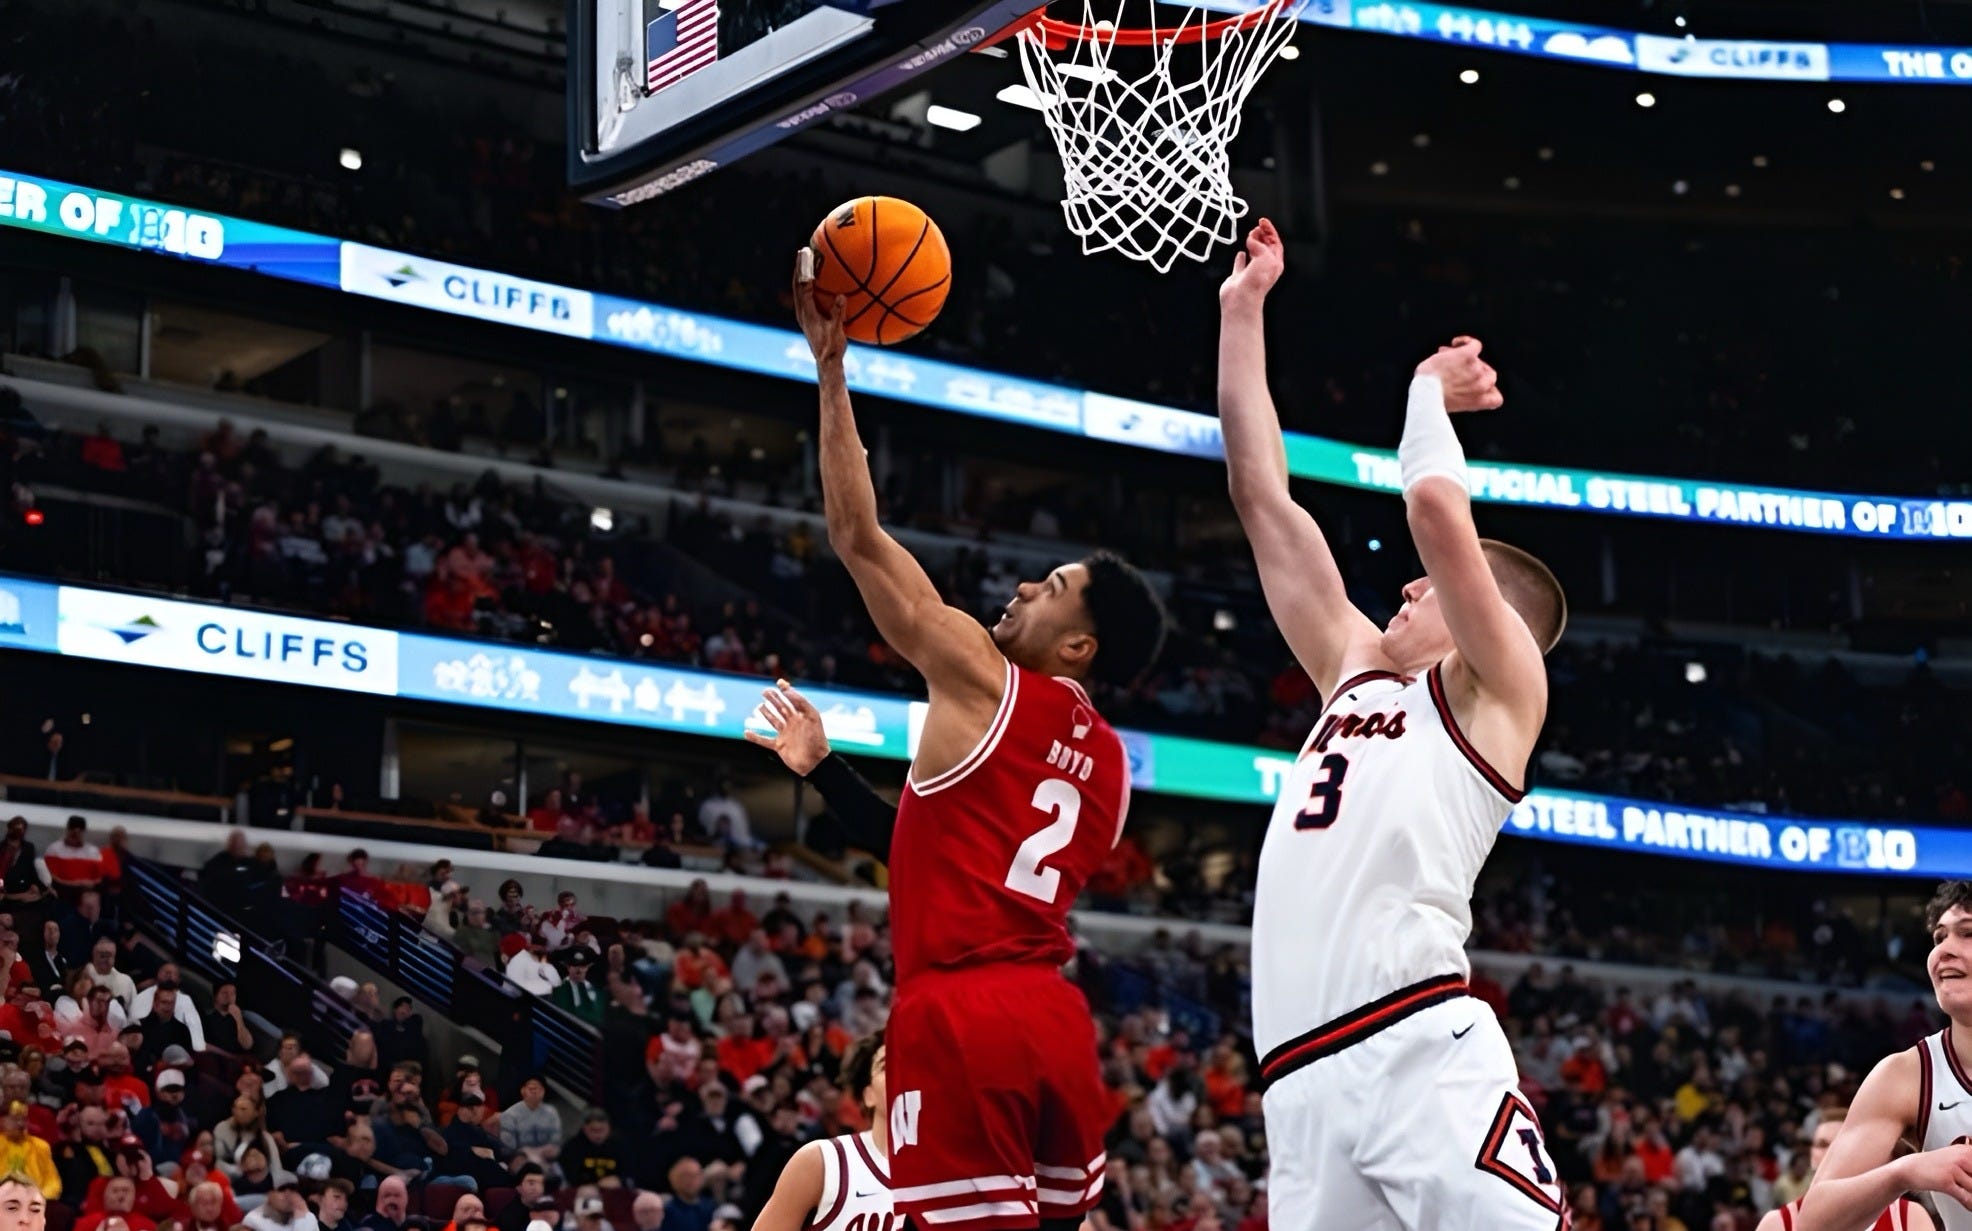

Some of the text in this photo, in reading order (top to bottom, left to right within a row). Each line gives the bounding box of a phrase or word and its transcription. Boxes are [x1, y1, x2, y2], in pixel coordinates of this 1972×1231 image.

[1882, 50, 1944, 78] THE
[59, 191, 123, 235] OF
[1586, 476, 1691, 517] STEEL
[1695, 487, 1846, 530] PARTNER
[1852, 501, 1897, 533] OF
[196, 622, 368, 672] CLIFFS
[1046, 739, 1094, 781] BOYD
[1293, 753, 1349, 832] 3
[1004, 777, 1082, 904] 2
[1511, 795, 1616, 839] STEEL
[1622, 806, 1772, 859] PARTNER
[1779, 826, 1830, 863] OF
